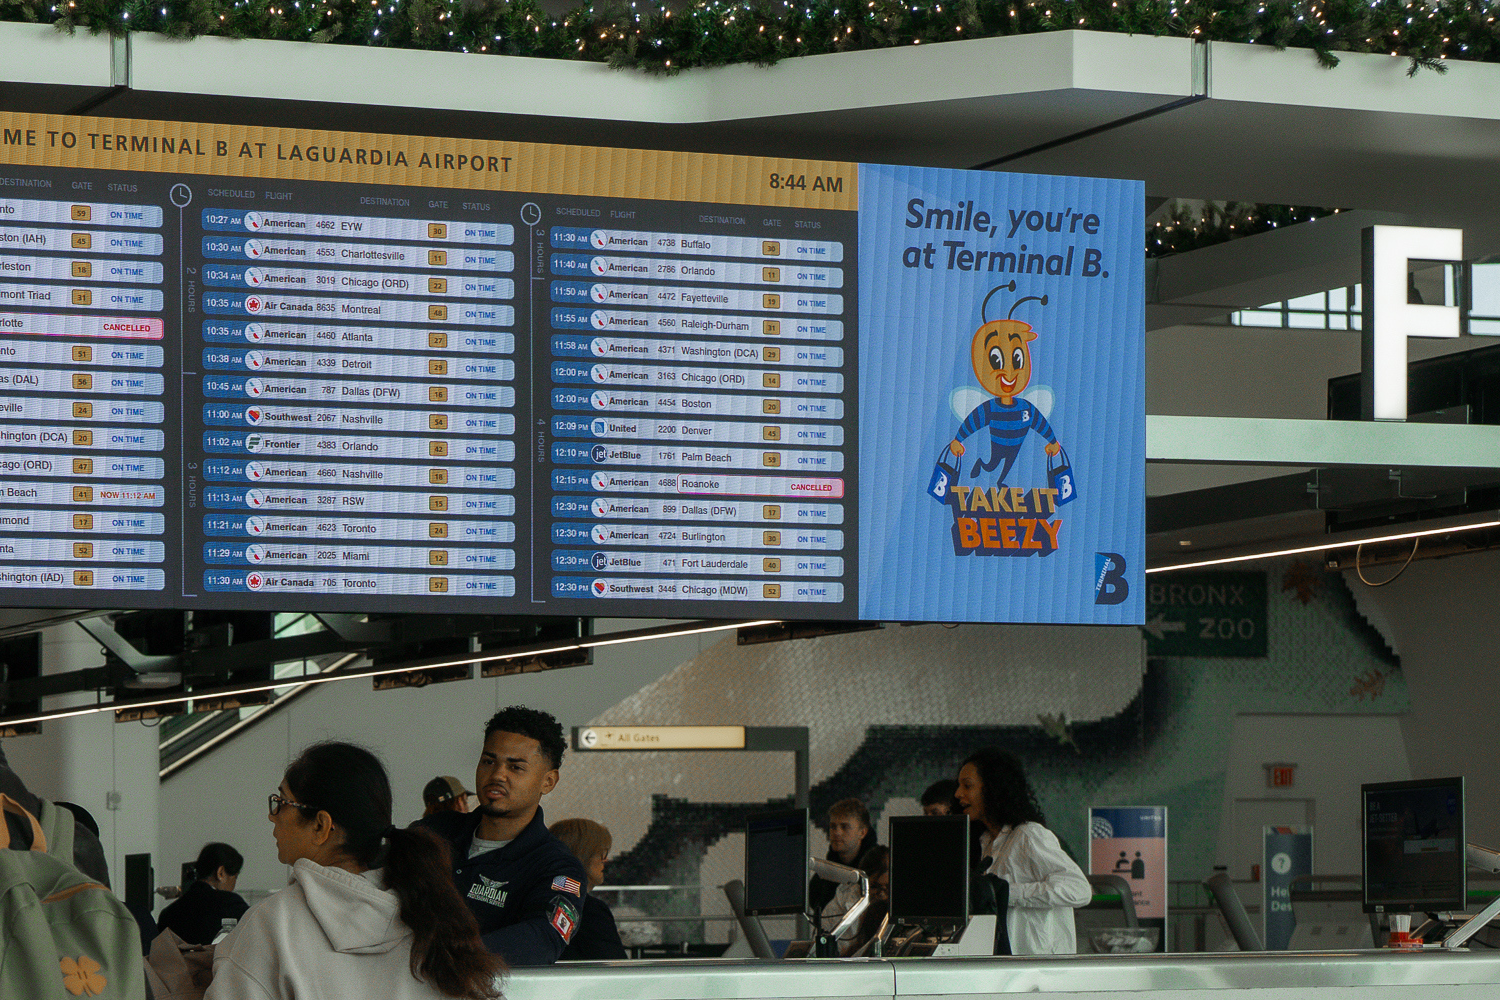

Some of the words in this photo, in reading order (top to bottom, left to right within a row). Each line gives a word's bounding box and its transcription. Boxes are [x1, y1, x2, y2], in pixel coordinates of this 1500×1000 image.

[47, 130, 77, 149] TO
[88, 133, 205, 156] TERMINAL
[216, 140, 228, 157] B
[239, 141, 266, 159] AT
[276, 144, 408, 167] LAGUARDIA
[418, 152, 512, 173] AIRPORT
[770, 173, 806, 191] 8:44
[812, 176, 844, 193] AM
[205, 215, 228, 224] 10:27
[264, 218, 305, 228] American
[316, 220, 334, 229] 4662
[341, 222, 362, 231] EYW
[905, 197, 997, 238] Smile,
[554, 233, 575, 242] 11:30
[608, 236, 647, 246] American
[657, 238, 675, 247] 4738
[681, 240, 710, 249] Buffalo
[902, 241, 935, 269] at
[943, 239, 1074, 276] Terminal
[1082, 248, 1108, 278] B.
[103, 323, 150, 332] CANCELLED
[1369, 225, 1463, 420] F
[265, 440, 299, 449] Frontier
[317, 441, 335, 450] 4383
[342, 442, 378, 451] Orlando
[555, 476, 576, 484] 12:15
[609, 478, 648, 487] American
[658, 479, 676, 487] 4688
[682, 480, 718, 489] Roanoke
[950, 485, 1027, 512] TAKE
[1031, 487, 1058, 513] IT
[957, 516, 1062, 550] BEEZY
[1095, 557, 1111, 590] TERMINAL
[1095, 552, 1128, 604] B
[555, 583, 576, 591] 12:30
[609, 584, 653, 593] Southwest
[682, 585, 717, 596] Chicago
[719, 586, 747, 597] (MDW)
[1149, 584, 1245, 606] BRONX
[1199, 617, 1255, 640] ZOO
[618, 734, 630, 742] All
[634, 734, 660, 742] Gates
[1274, 768, 1292, 787] EXIT
[470, 883, 508, 902] GUARDIAN
